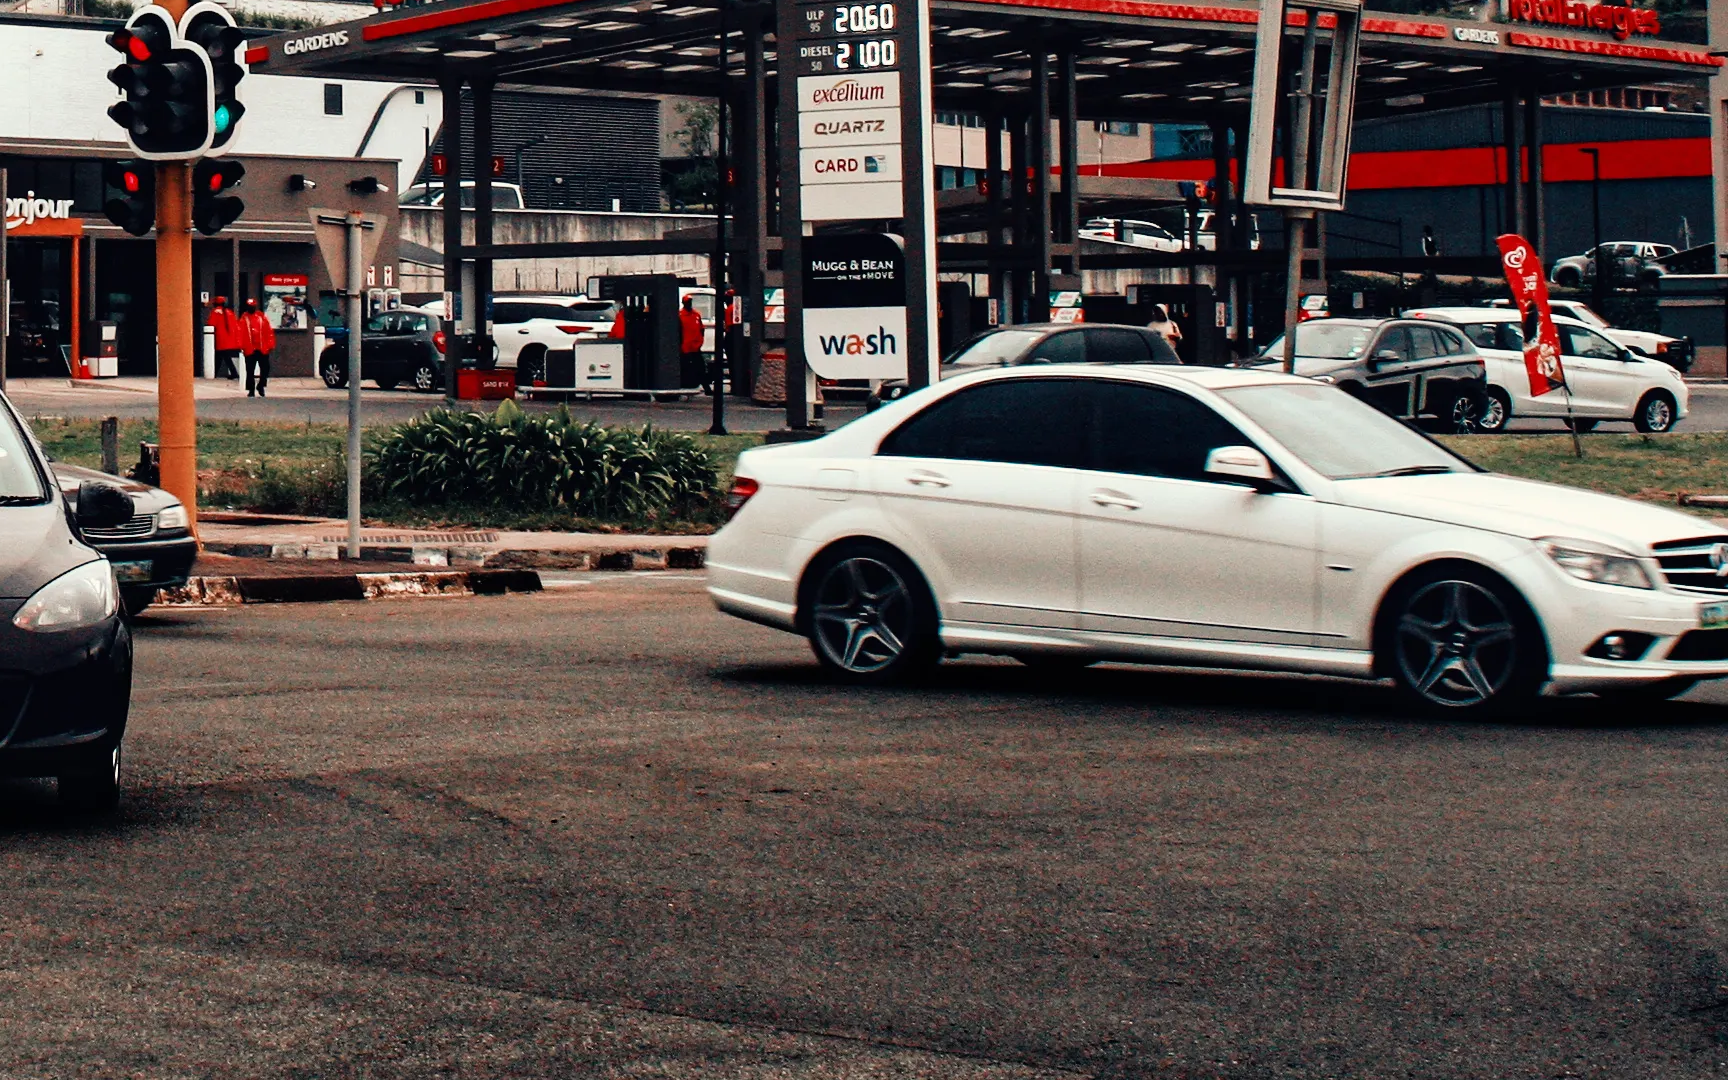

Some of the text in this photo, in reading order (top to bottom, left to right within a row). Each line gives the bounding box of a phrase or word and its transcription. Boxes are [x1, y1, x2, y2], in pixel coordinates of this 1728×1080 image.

[806, 10, 825, 21] ULP
[809, 22, 821, 32] 95
[1453, 27, 1500, 44] GARDENS
[283, 30, 349, 56] GARDENS
[800, 46, 833, 57] DIESEL
[811, 61, 822, 71] 50
[813, 82, 884, 104] excellium
[814, 120, 885, 135] QUARTZ
[437, 159, 442, 170] 1
[493, 160, 499, 171] 2
[814, 158, 858, 173] CARD
[812, 259, 894, 271] MUGG & BEAN
[867, 271, 894, 279] MOVE
[819, 325, 896, 355] wash
